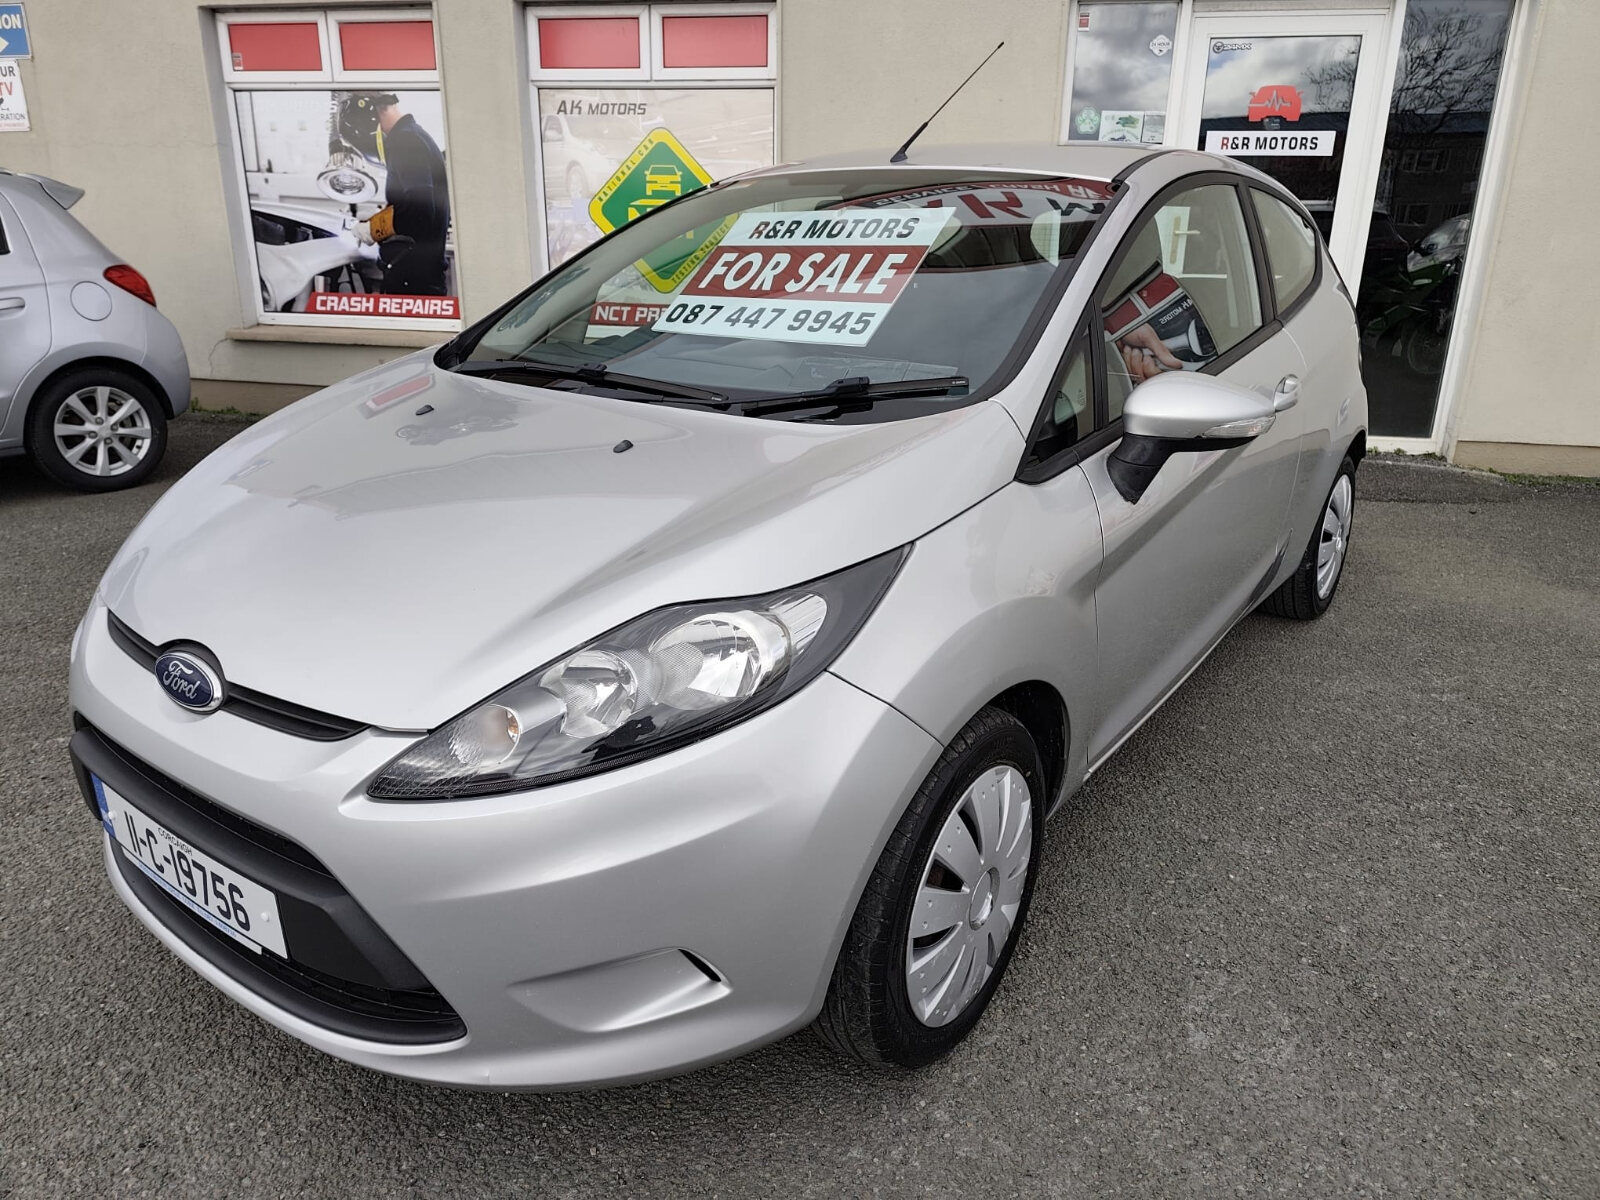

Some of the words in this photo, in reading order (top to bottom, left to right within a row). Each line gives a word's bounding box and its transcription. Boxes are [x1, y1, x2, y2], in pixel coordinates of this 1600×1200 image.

[557, 100, 582, 115] AK
[587, 103, 647, 115] MOTORS
[1220, 136, 1250, 150] R&R
[1255, 136, 1319, 150] MOTORS
[749, 219, 803, 240] R&R
[801, 217, 920, 240] MOTORS
[698, 252, 791, 291] FOR
[785, 252, 908, 295] SALE
[316, 295, 374, 313] CRASH
[378, 297, 455, 315] REPAIRS
[595, 305, 631, 321] NCT
[665, 303, 724, 325] 087
[724, 306, 787, 329] 447
[787, 309, 876, 335] 9945
[163, 660, 201, 699] Ford
[124, 810, 251, 932] 11-C-19756
